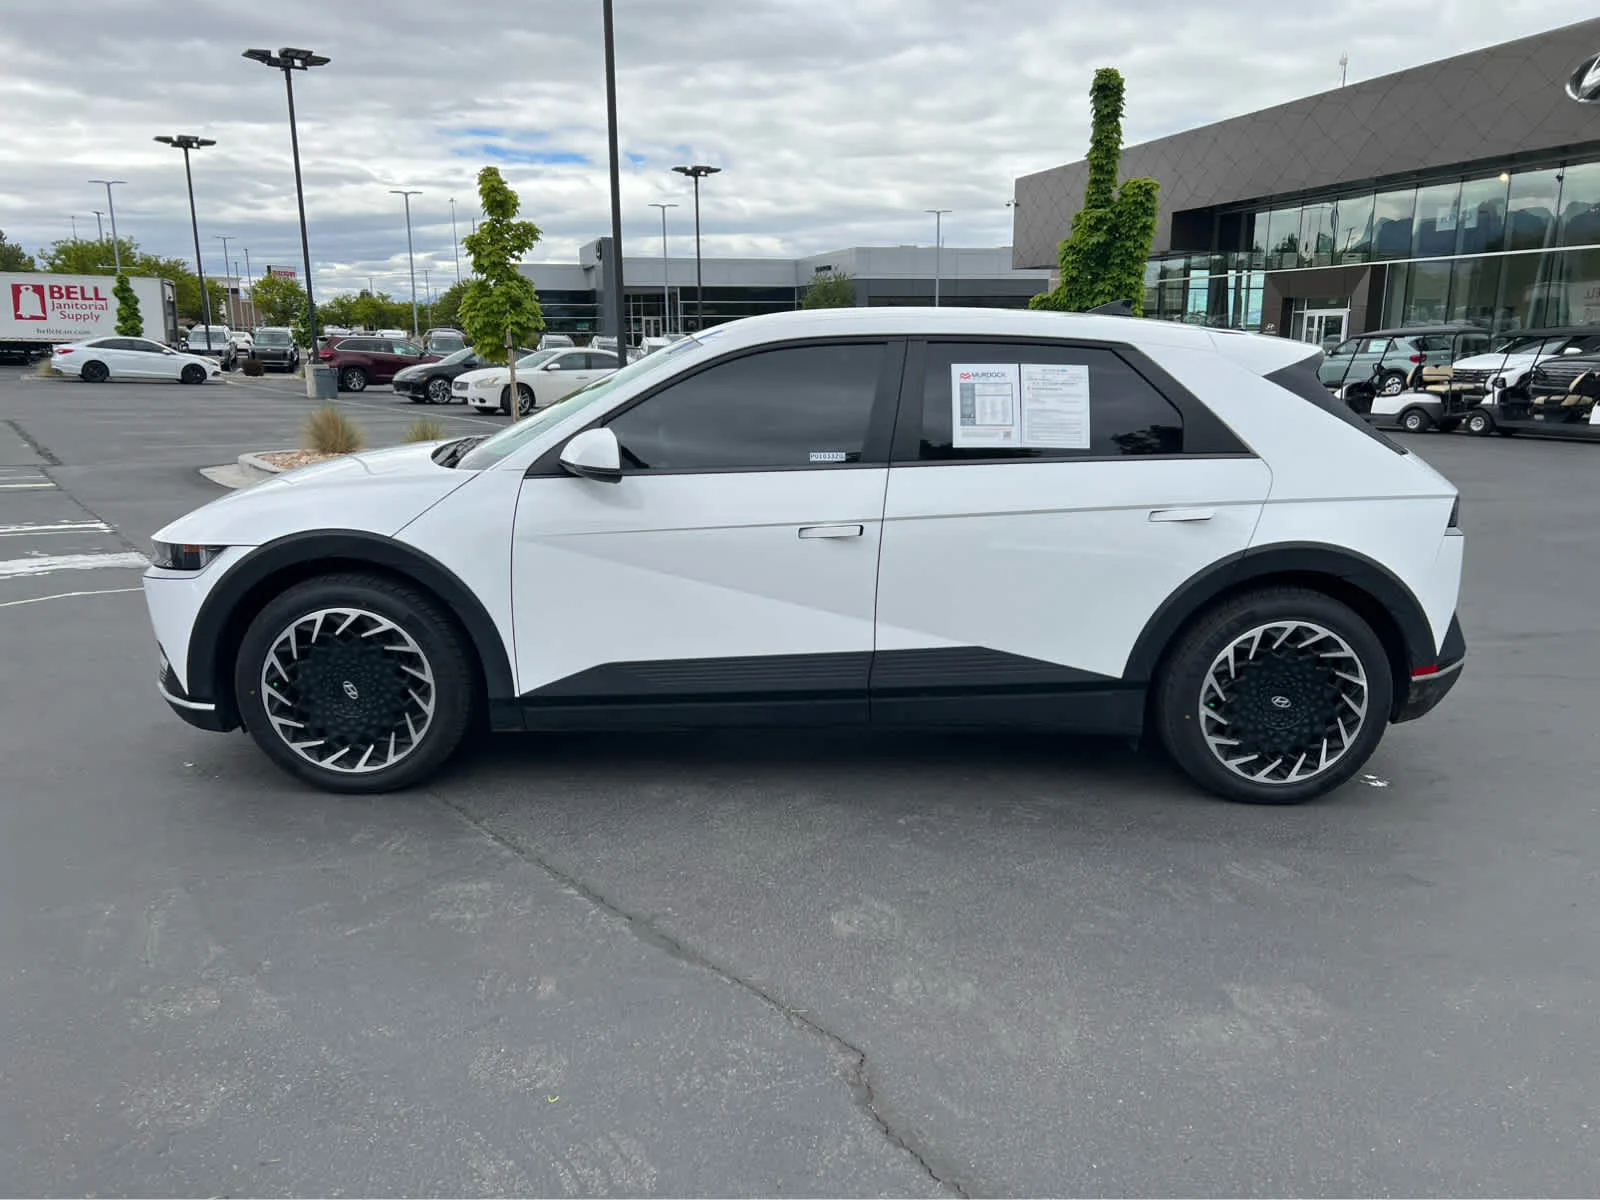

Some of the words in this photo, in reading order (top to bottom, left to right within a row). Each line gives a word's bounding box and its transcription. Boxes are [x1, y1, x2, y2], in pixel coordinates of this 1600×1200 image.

[48, 284, 108, 301] BELL
[51, 300, 109, 312] Janitorial
[60, 310, 101, 322] Supply
